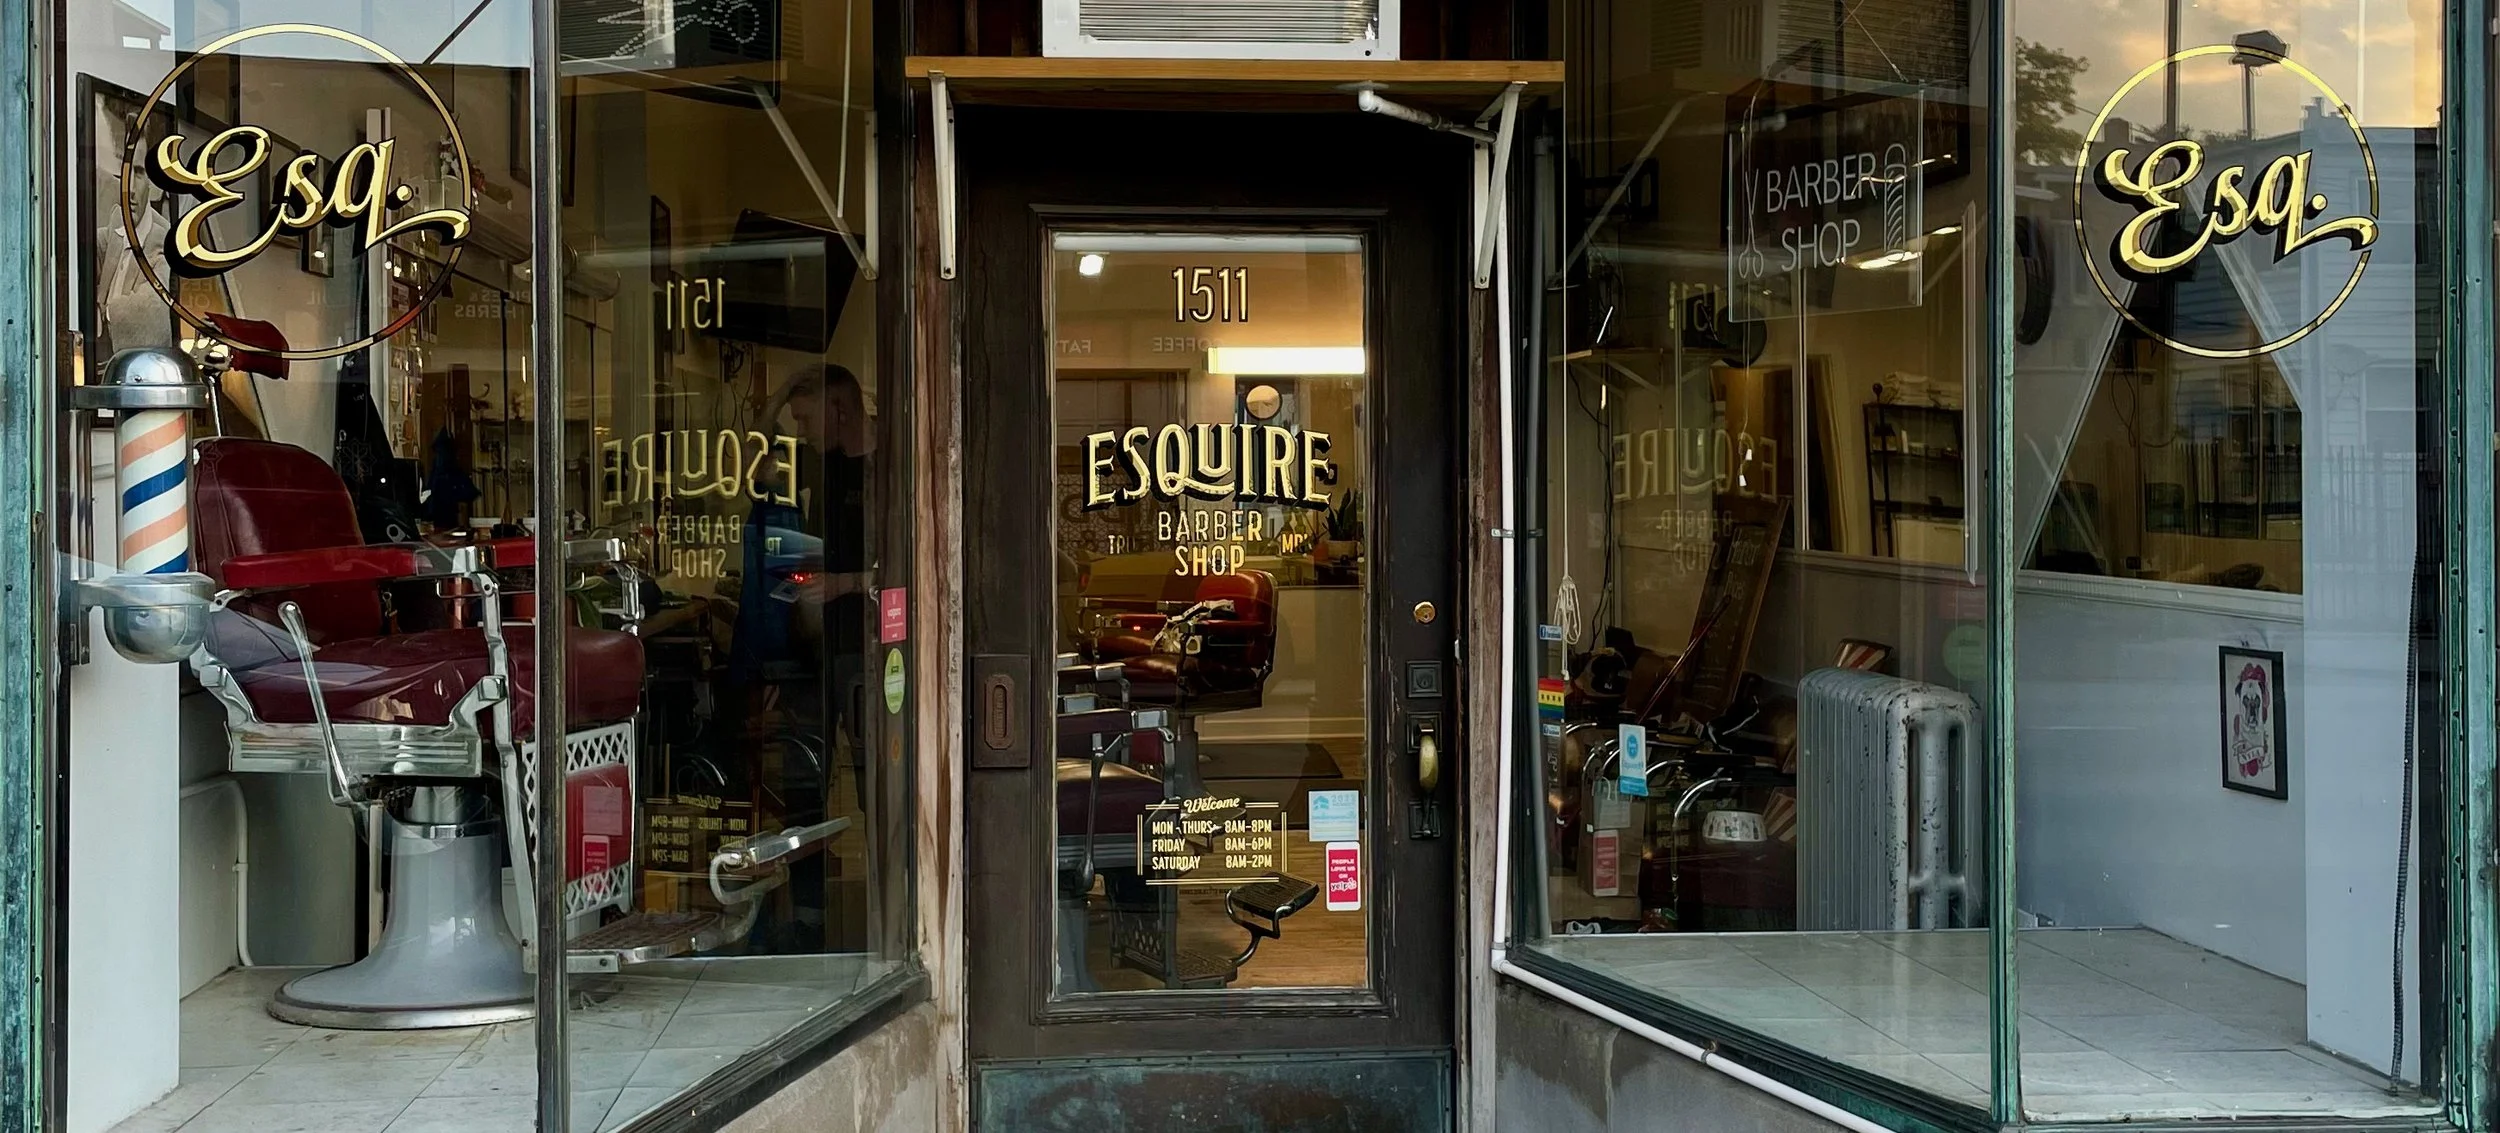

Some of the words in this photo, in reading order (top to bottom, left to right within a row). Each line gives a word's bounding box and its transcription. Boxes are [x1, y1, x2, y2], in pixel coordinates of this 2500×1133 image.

[152, 126, 470, 272] Esq.
[1766, 151, 1878, 214] BARBER
[2099, 140, 2378, 277] Esq.
[1781, 218, 1861, 272] SHOP
[1172, 267, 1249, 322] 1511
[1084, 422, 1333, 509] ESQUIRE
[1157, 511, 1263, 542] BARBER
[1174, 545, 1246, 577] SHOP
[1152, 821, 1174, 835] MON
[1182, 820, 1213, 834] THURS
[1224, 819, 1272, 833] 8AM-8PM
[1183, 797, 1241, 814] Welcome
[1152, 838, 1186, 852] FRIDAY
[1224, 837, 1272, 851] 8AM-6PM
[1152, 855, 1201, 870] SATURDAY
[1225, 854, 1272, 868] 8AM-2PM
